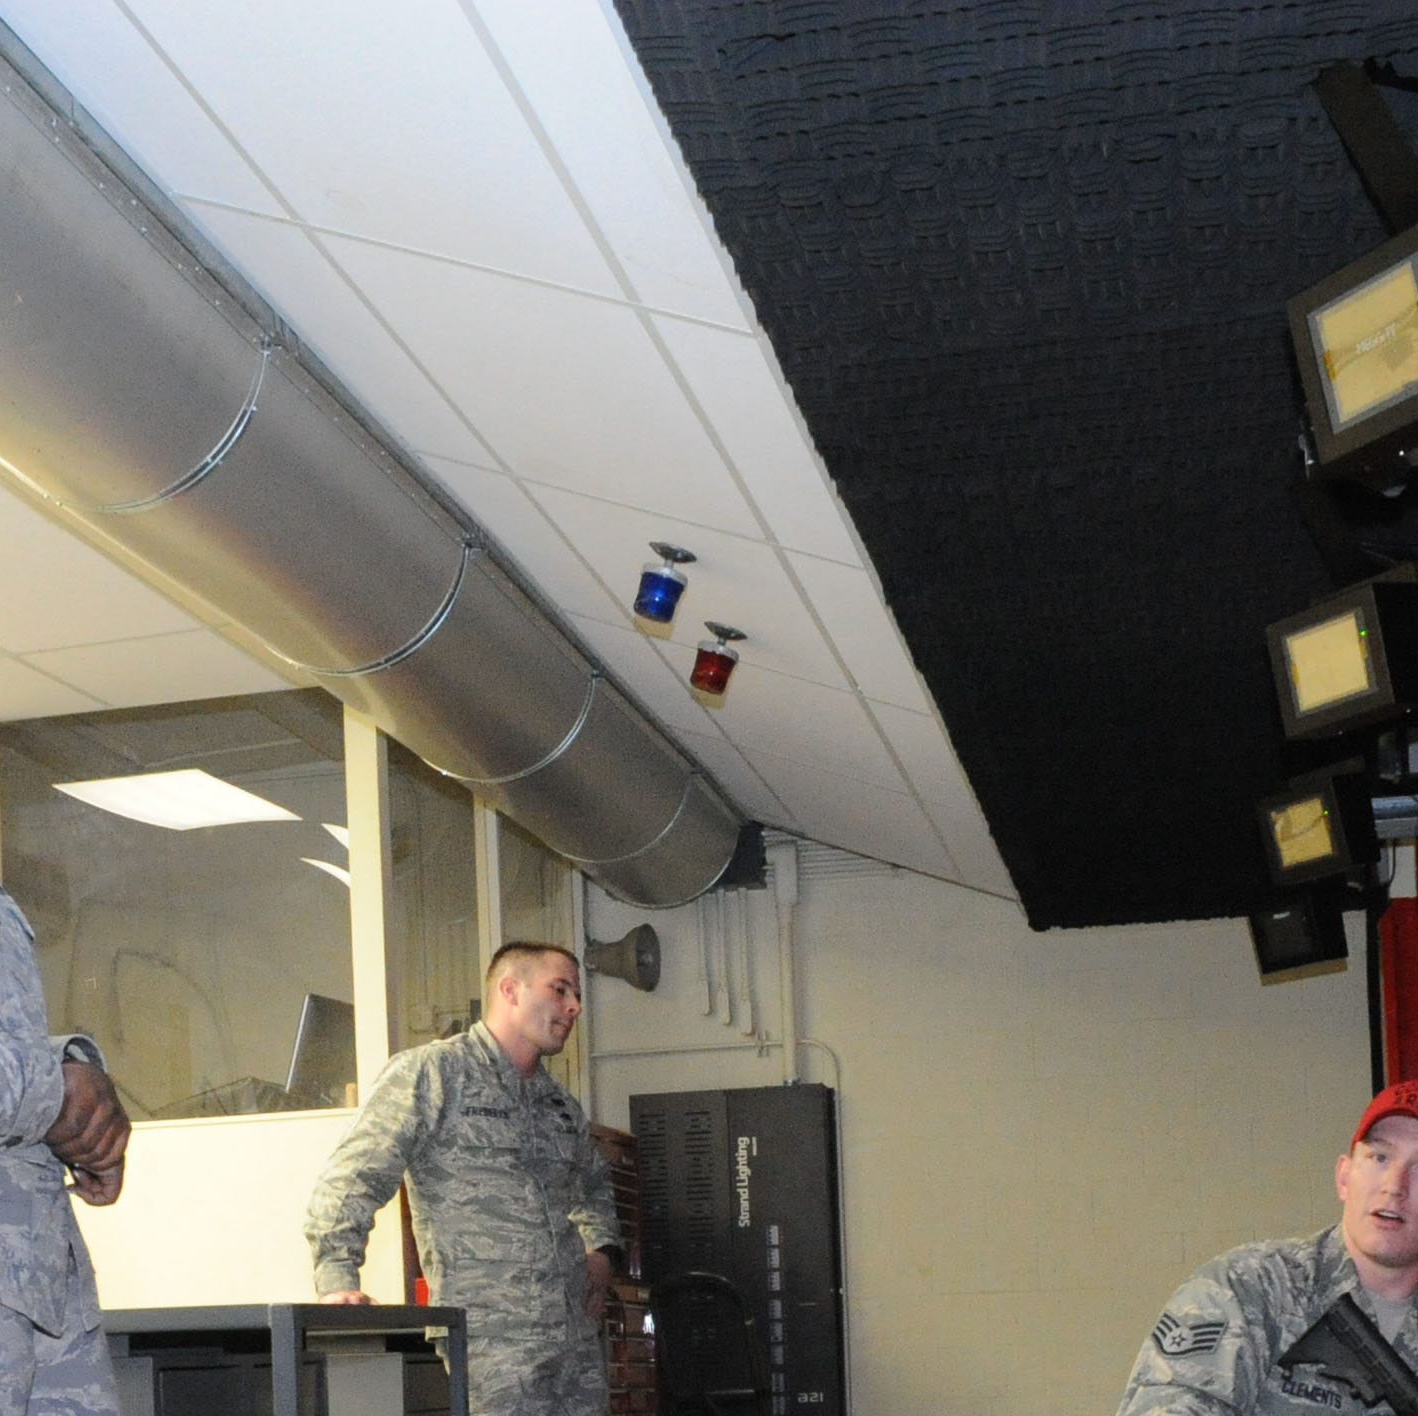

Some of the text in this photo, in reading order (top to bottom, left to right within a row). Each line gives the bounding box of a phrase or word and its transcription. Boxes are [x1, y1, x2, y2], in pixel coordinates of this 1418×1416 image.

[735, 1136, 752, 1228] Strand Lighting
[1281, 1379, 1342, 1410] CLEMENTS
